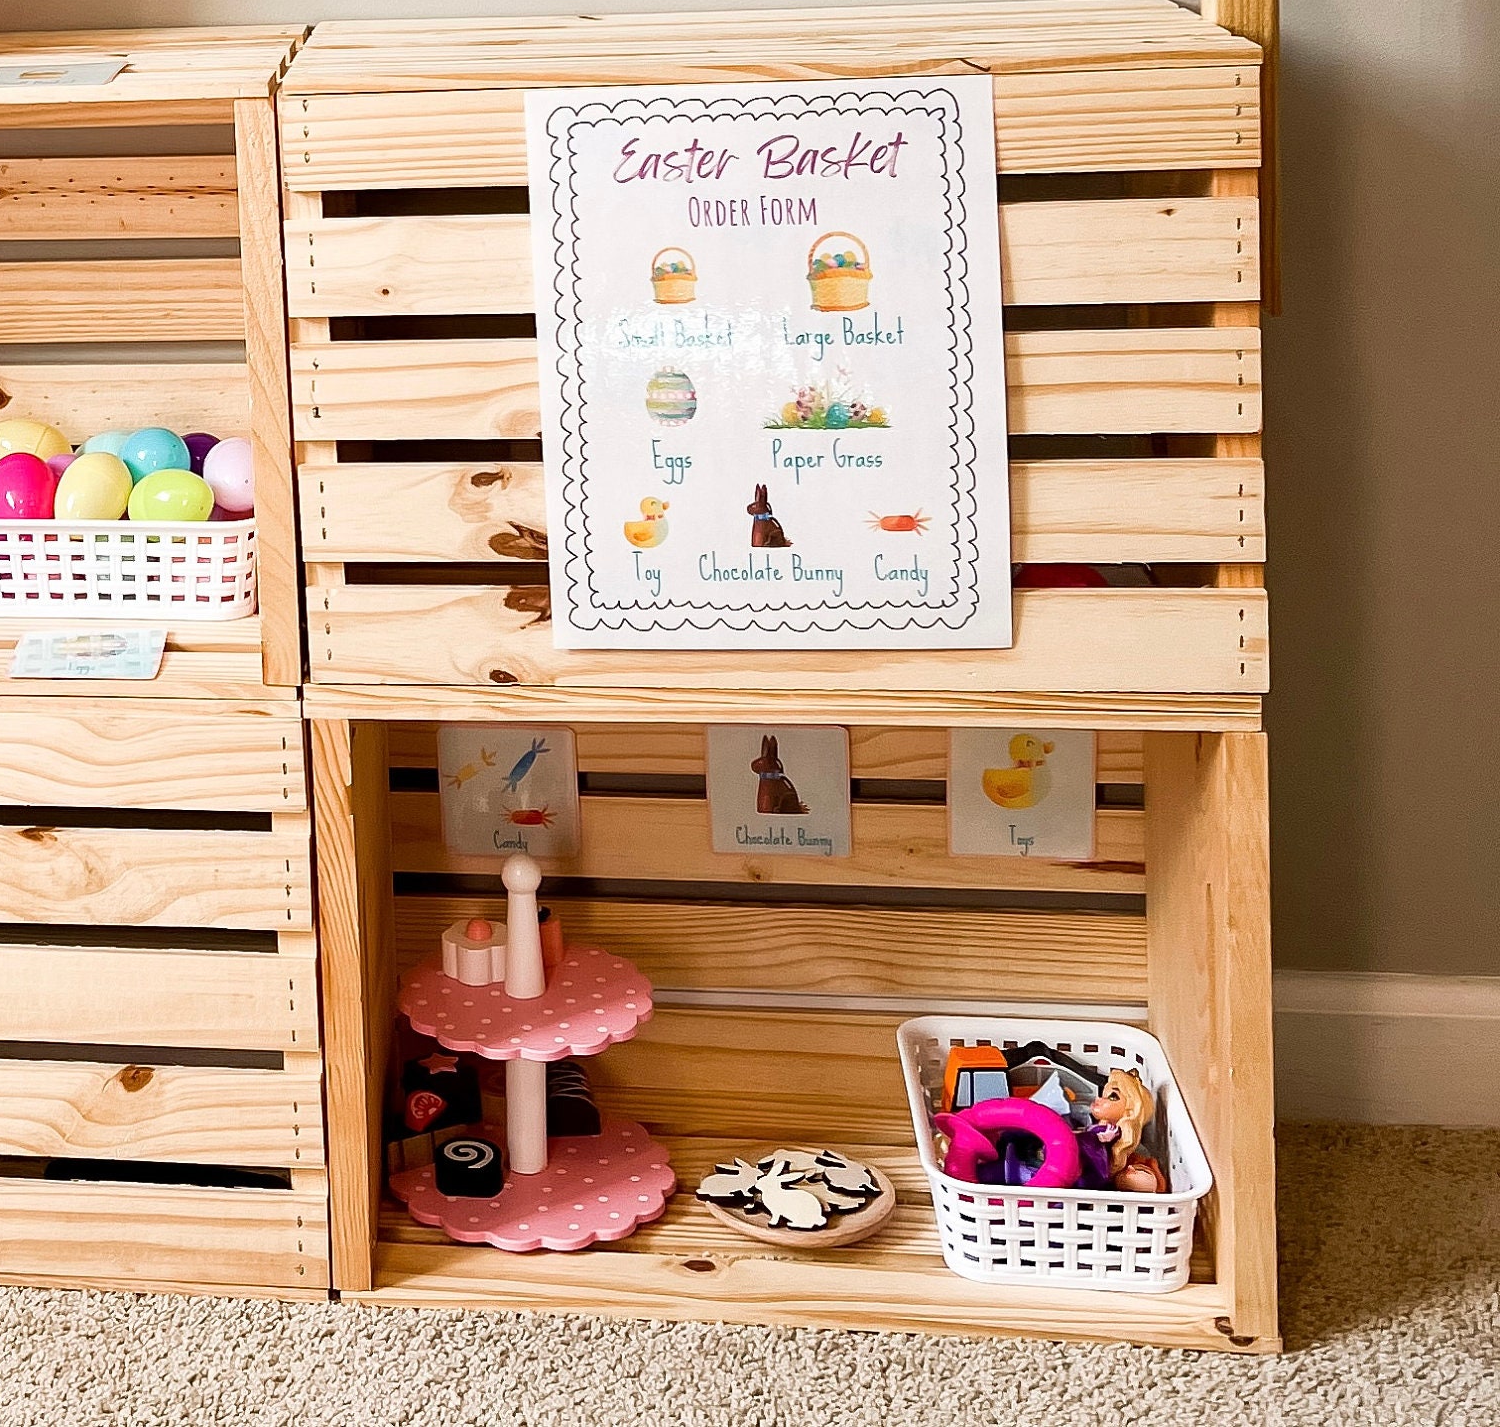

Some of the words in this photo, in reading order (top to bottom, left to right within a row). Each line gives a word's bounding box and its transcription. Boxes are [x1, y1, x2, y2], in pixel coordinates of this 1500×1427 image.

[612, 136, 741, 184] Easter
[756, 131, 909, 180] Basket
[687, 196, 750, 228] ORDER
[760, 195, 819, 227] FORM
[781, 315, 835, 362] Large
[842, 311, 905, 347] Basket
[651, 439, 693, 485] Eggs
[771, 438, 825, 485] Paper
[832, 437, 884, 469] Grass
[631, 550, 662, 597] Toy
[698, 550, 784, 583] Chocolate
[791, 554, 844, 597] Bunny
[873, 552, 930, 597] Candy
[492, 829, 529, 854] Candy
[735, 823, 793, 846] Chocolate
[797, 827, 833, 857] Bunny
[1007, 823, 1035, 857] Toys
